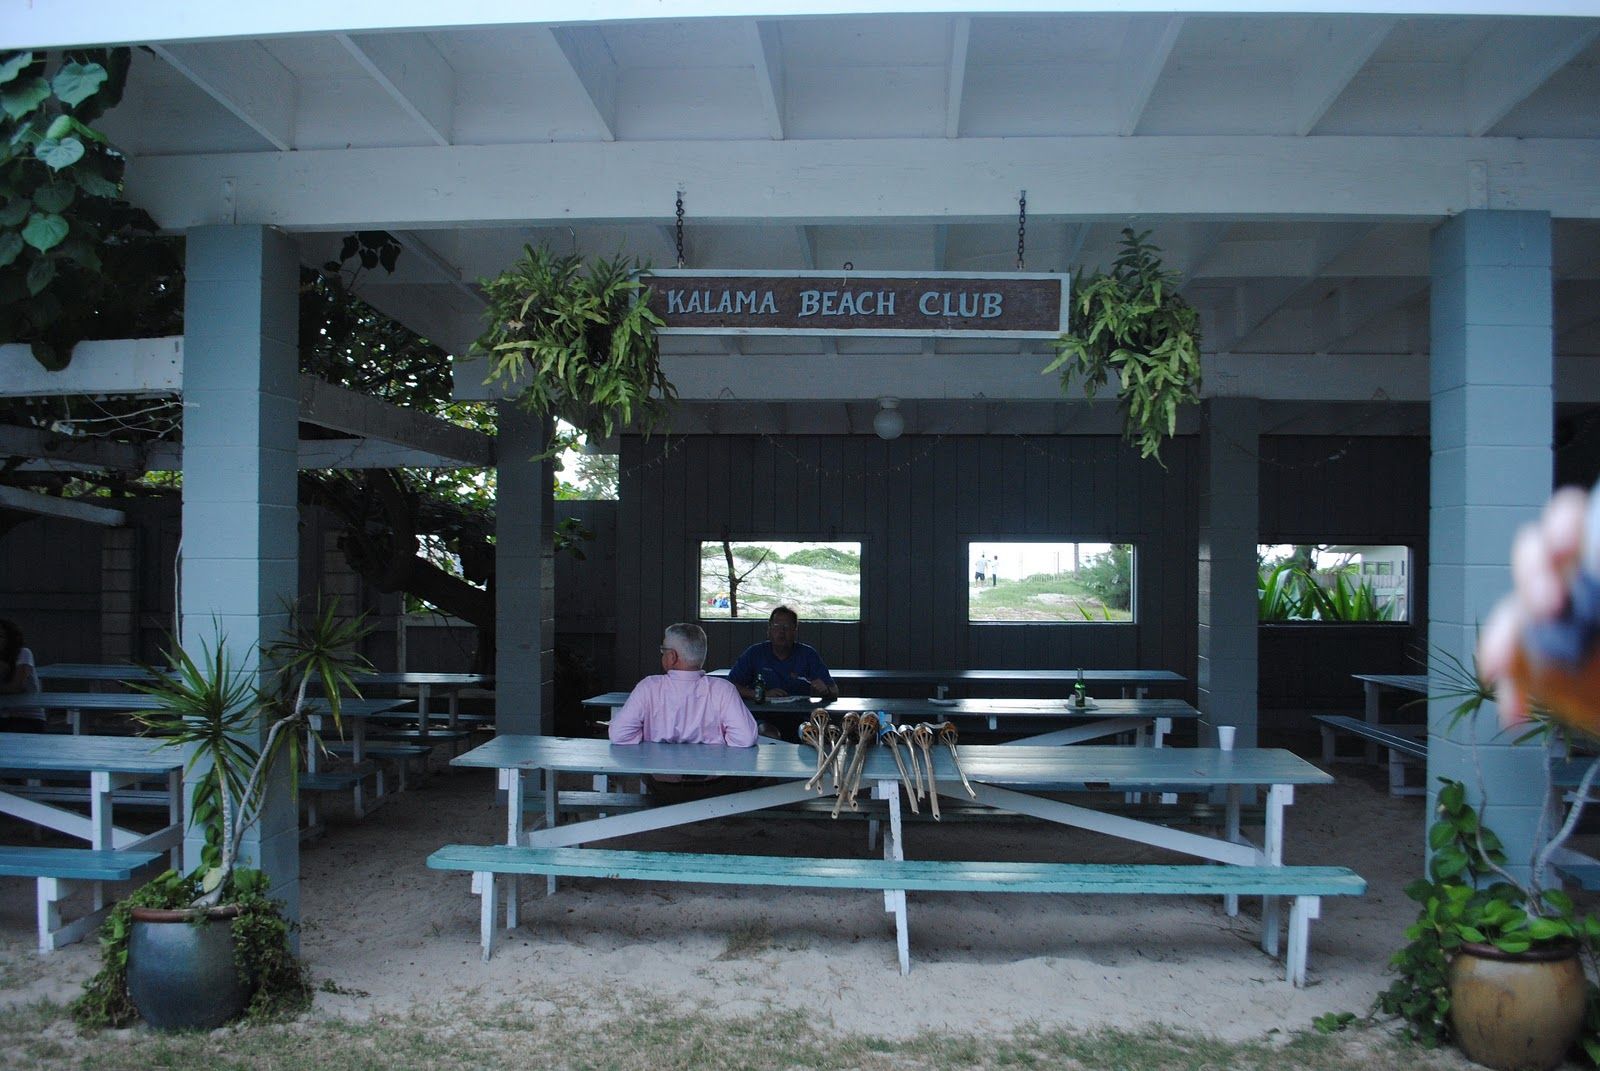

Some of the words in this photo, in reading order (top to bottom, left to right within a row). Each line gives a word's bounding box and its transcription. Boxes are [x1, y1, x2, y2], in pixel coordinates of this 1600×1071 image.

[667, 289, 779, 315] KALAMA
[798, 290, 896, 317] BEACH
[918, 290, 1004, 318] CLUB
